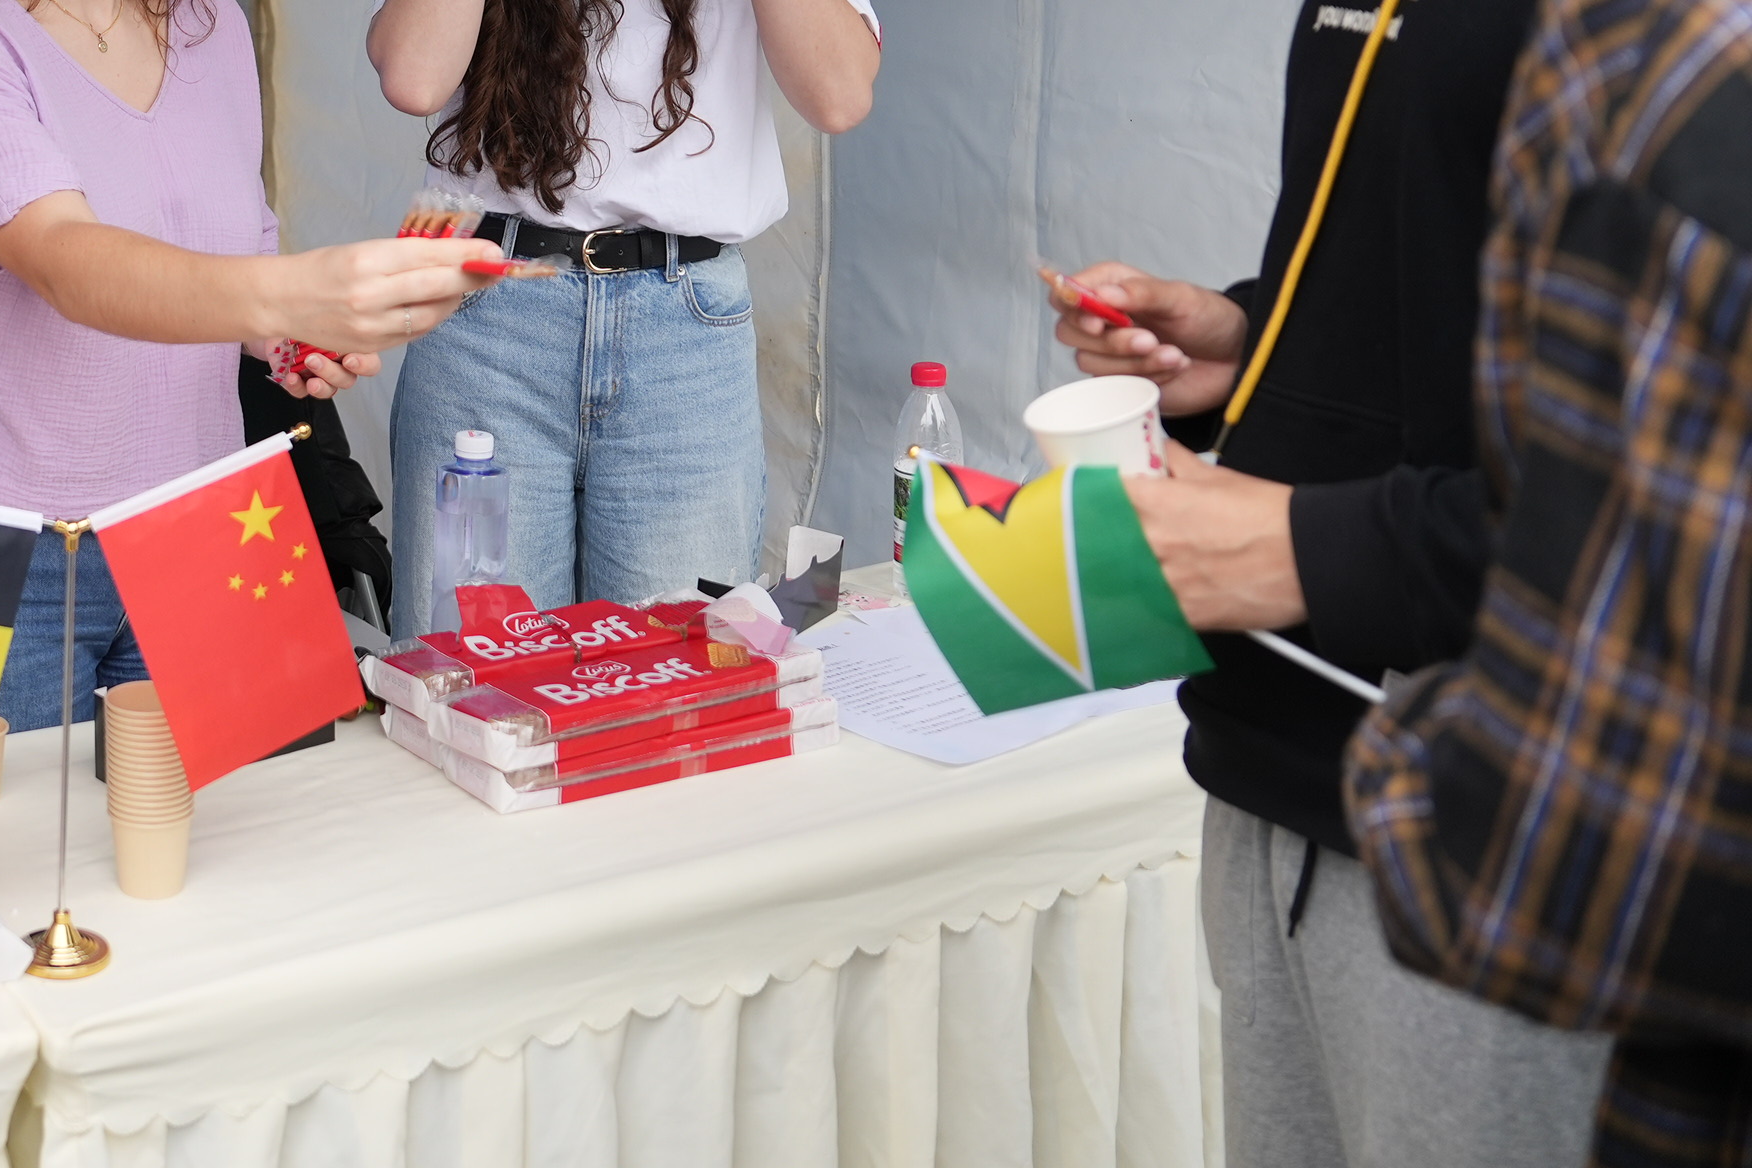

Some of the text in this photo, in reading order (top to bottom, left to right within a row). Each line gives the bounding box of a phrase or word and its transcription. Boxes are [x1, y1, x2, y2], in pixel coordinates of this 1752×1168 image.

[463, 614, 640, 661] Biscoff
[533, 656, 705, 705] Biscoff
[583, 662, 622, 676] Lotus
